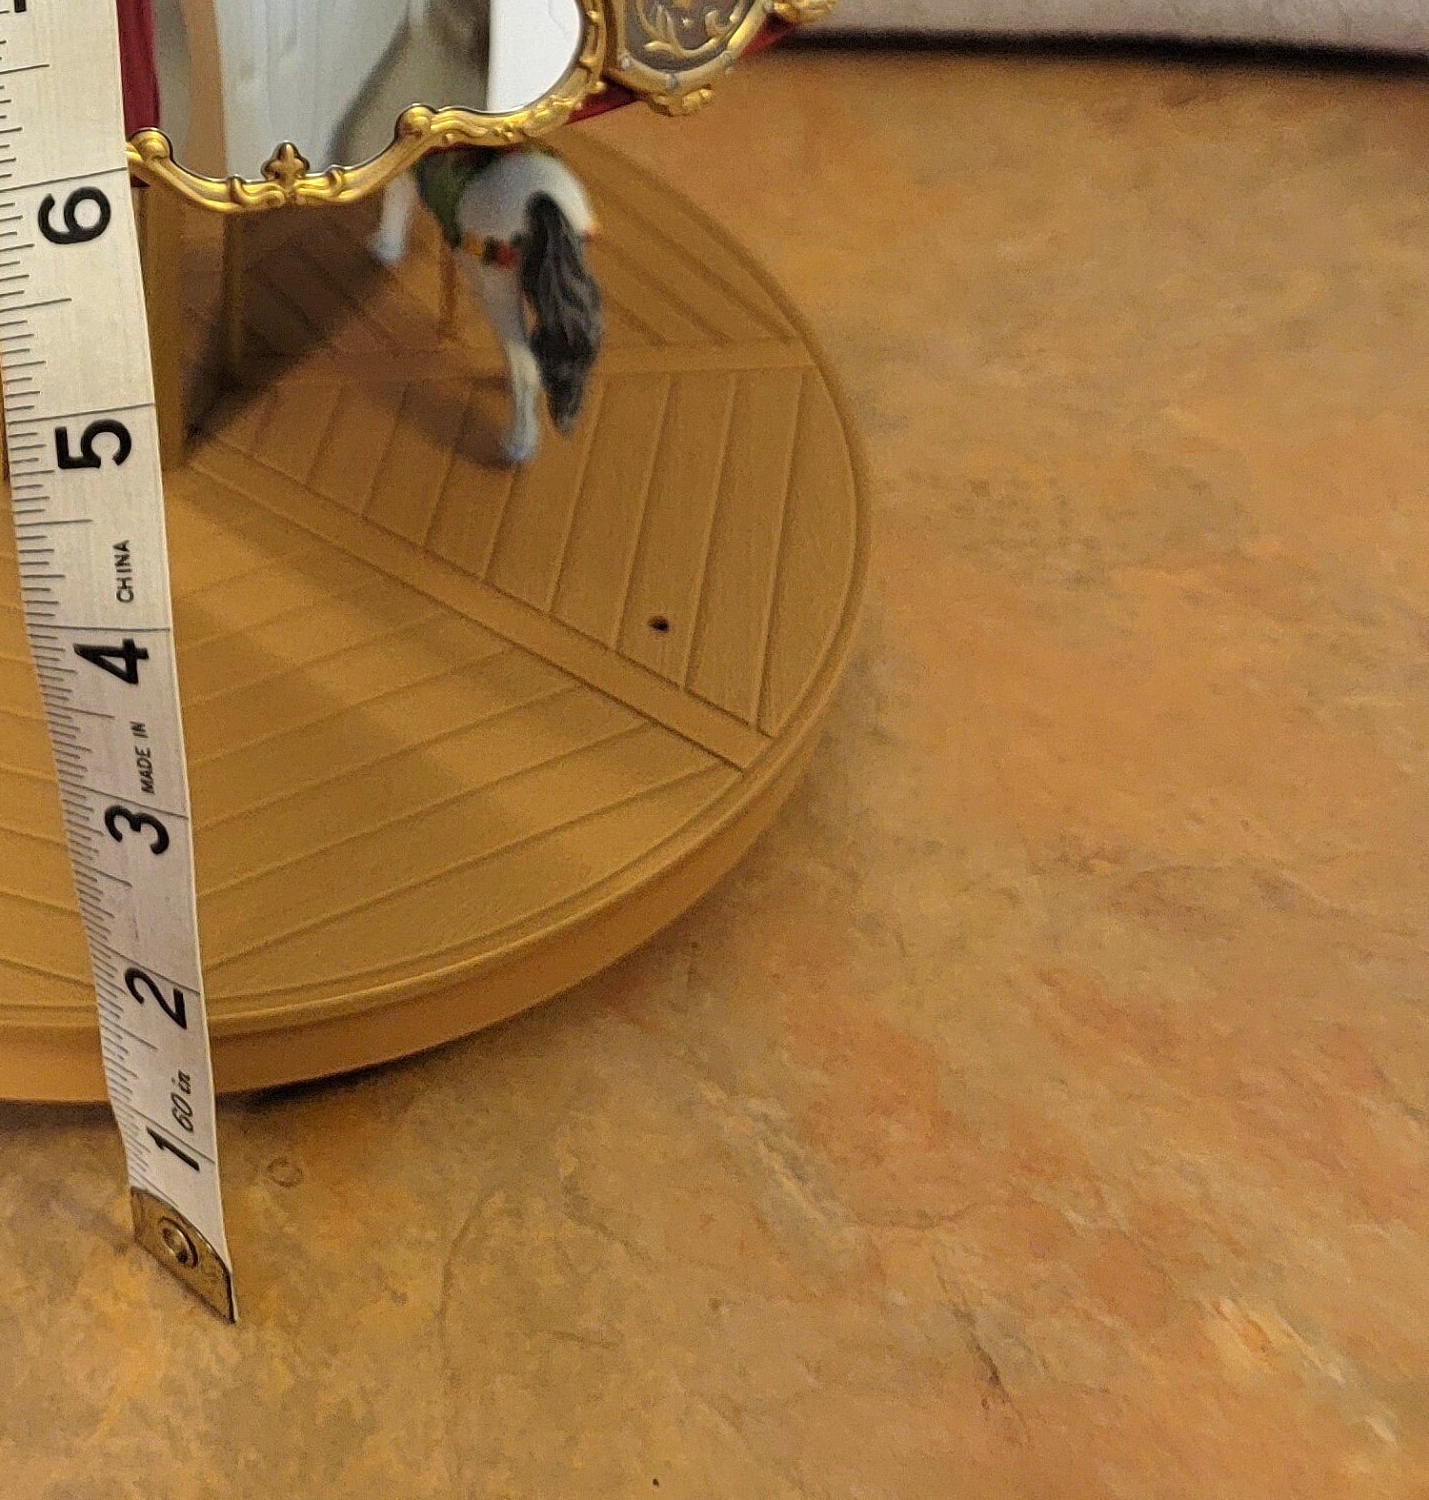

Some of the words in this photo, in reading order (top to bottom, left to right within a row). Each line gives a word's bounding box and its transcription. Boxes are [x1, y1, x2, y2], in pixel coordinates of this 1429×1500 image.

[38, 186, 111, 245] 6
[54, 418, 133, 470] 5
[112, 539, 134, 603] CHINA
[73, 638, 149, 685] 4
[129, 720, 146, 739] IN
[132, 748, 155, 796] MADE
[104, 805, 170, 855] 3
[124, 966, 187, 1030] 2
[171, 1069, 191, 1095] in
[171, 1092, 193, 1133] 60
[146, 1125, 200, 1172] 1
